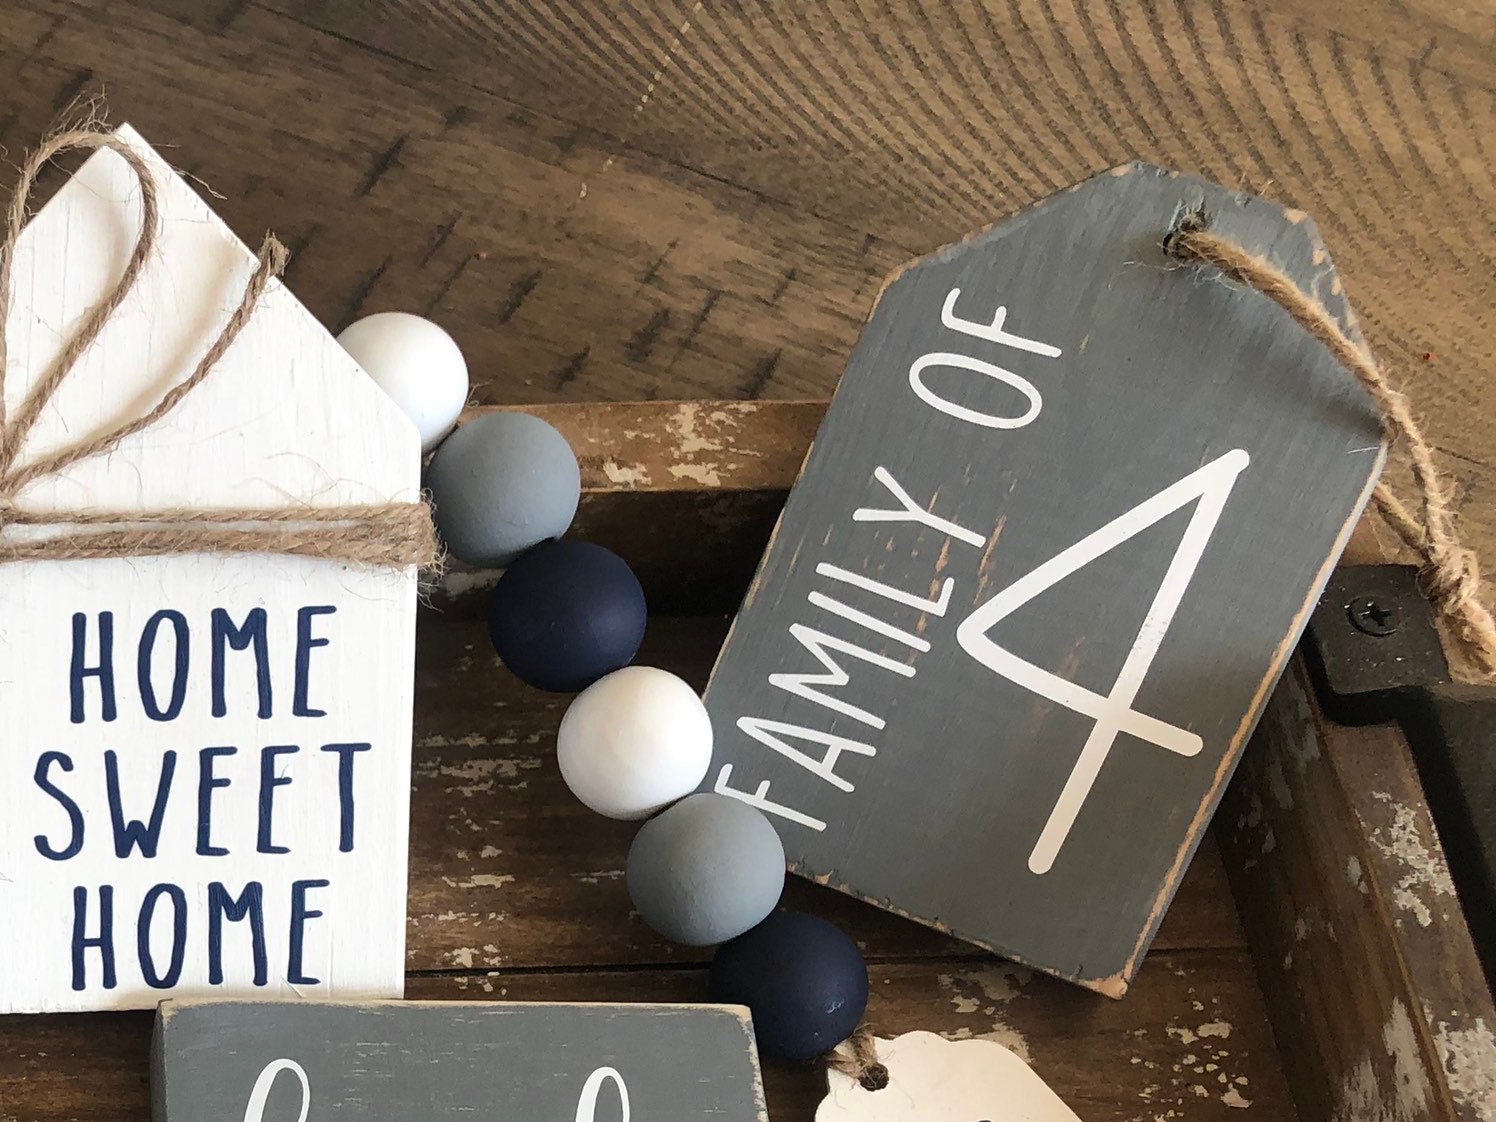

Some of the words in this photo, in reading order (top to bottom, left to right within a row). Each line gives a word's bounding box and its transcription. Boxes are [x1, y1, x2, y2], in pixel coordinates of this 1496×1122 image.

[713, 466, 986, 831] FAMILY
[908, 288, 1062, 430] OF
[70, 605, 337, 724] HOME
[955, 448, 1251, 875] 4
[33, 742, 372, 861] SWEET
[71, 879, 330, 992] HOME
